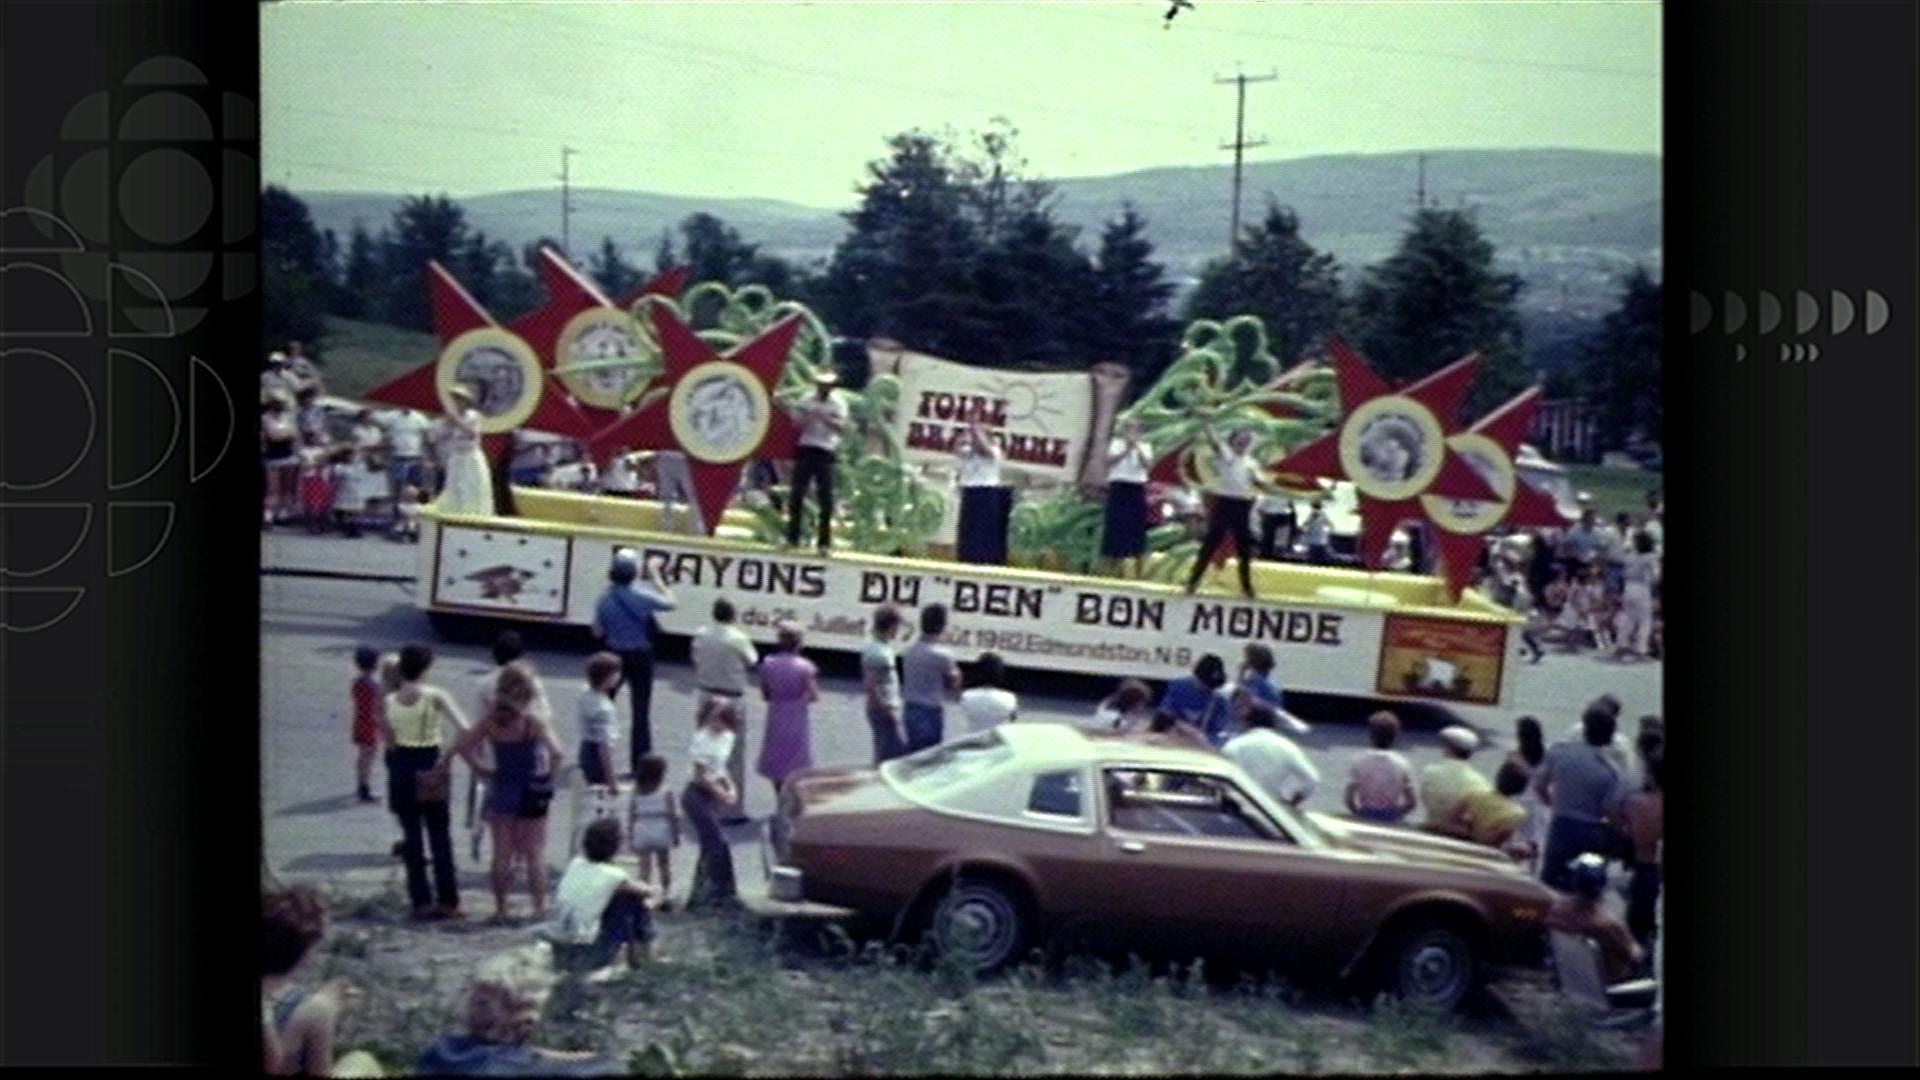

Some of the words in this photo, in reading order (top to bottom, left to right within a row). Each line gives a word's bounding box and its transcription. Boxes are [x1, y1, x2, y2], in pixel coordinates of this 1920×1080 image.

[917, 391, 1009, 427] FOIRE
[612, 545, 826, 603] RAYONS
[859, 571, 922, 607] DU
[1076, 592, 1165, 631] BON
[1190, 603, 1345, 646] MONDE
